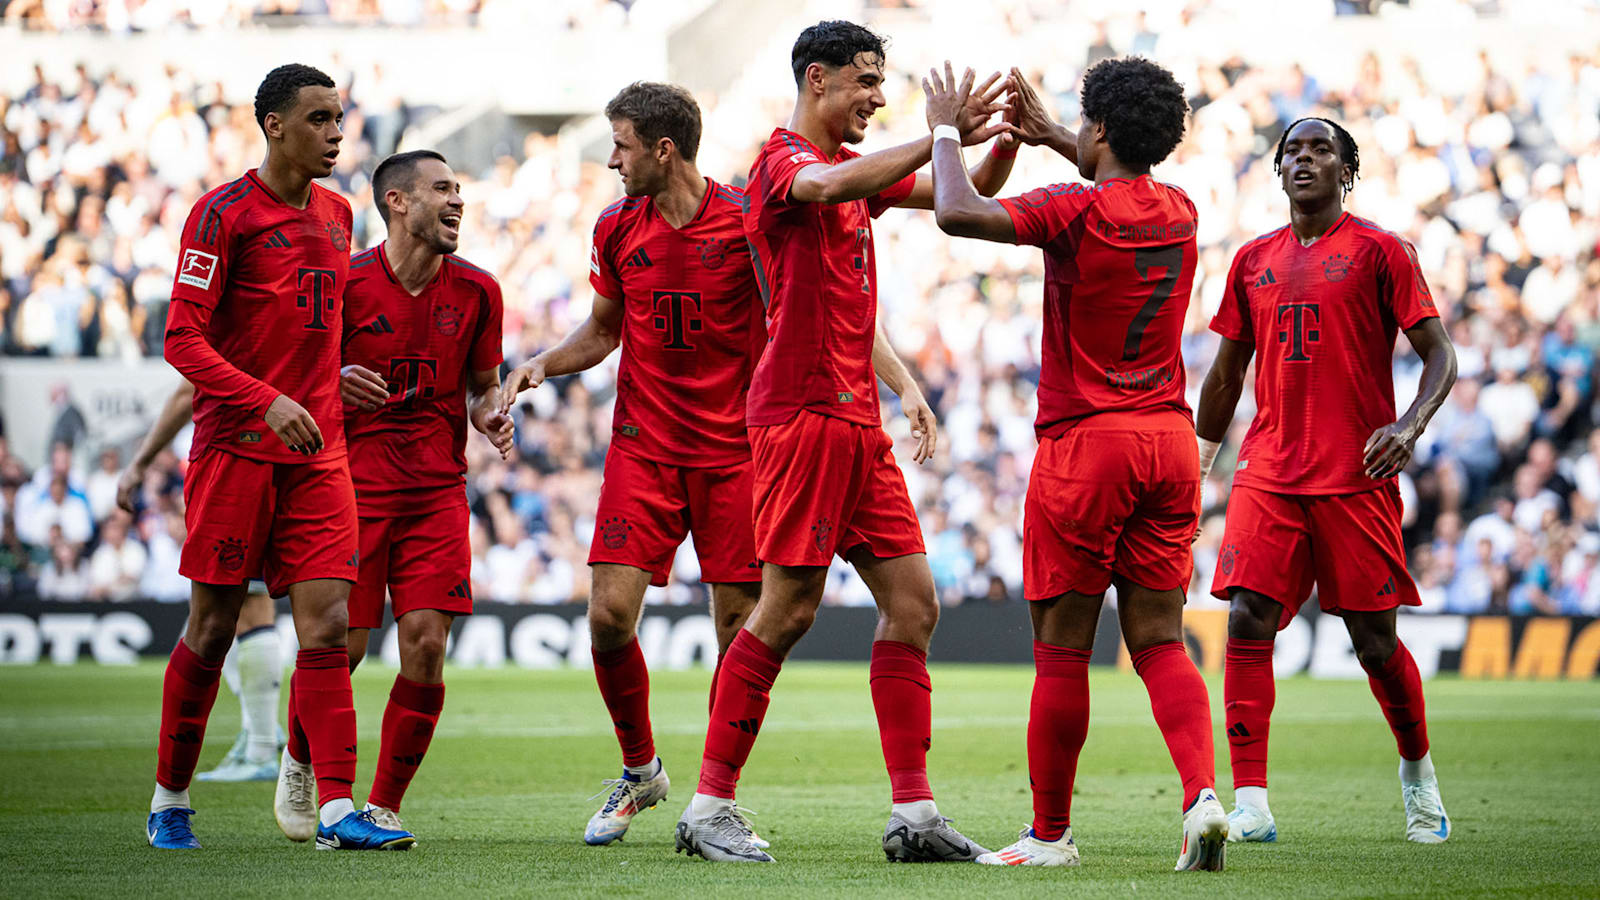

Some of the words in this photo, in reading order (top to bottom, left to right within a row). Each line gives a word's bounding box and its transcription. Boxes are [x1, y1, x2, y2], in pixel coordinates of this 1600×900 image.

[1096, 220, 1115, 239] FC
[1119, 224, 1167, 241] BAYERN
[297, 268, 336, 330] T
[652, 291, 702, 350] T
[1122, 247, 1184, 361] 7
[1277, 303, 1320, 362] T
